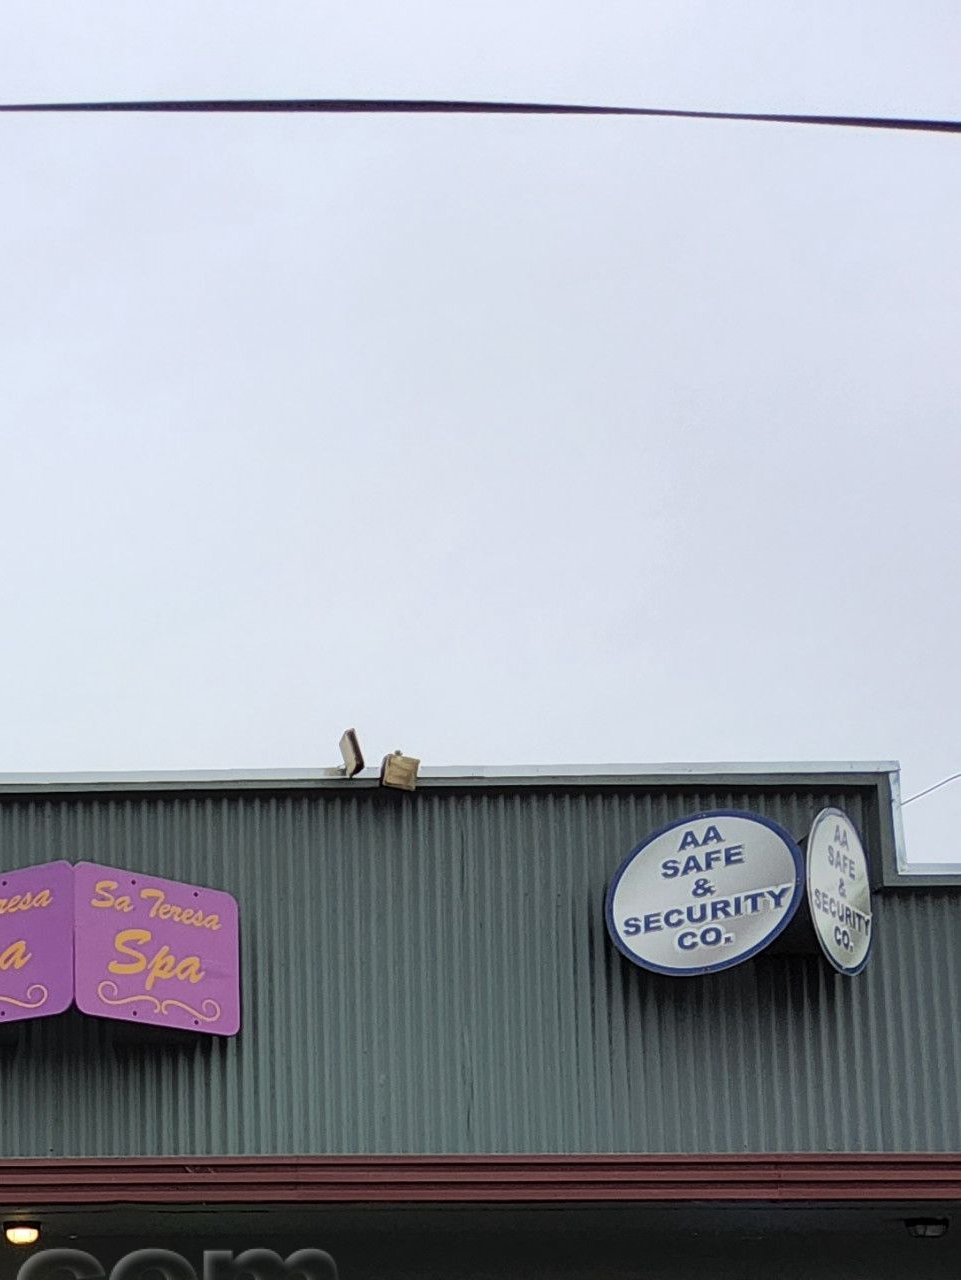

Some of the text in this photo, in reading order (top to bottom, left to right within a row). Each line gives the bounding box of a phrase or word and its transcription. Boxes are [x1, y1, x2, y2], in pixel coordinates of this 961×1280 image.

[677, 825, 726, 852] AA
[833, 824, 849, 851] AA
[661, 844, 745, 879] SAFE
[827, 845, 855, 880] SAFE
[692, 878, 716, 897] &
[838, 878, 847, 897] &
[91, 880, 222, 930] Sa Teresa
[623, 886, 792, 936] SECURITY
[814, 888, 871, 936] SECURITY
[677, 925, 733, 950] CO.
[834, 925, 854, 952] CO.
[108, 928, 206, 991] Spa
